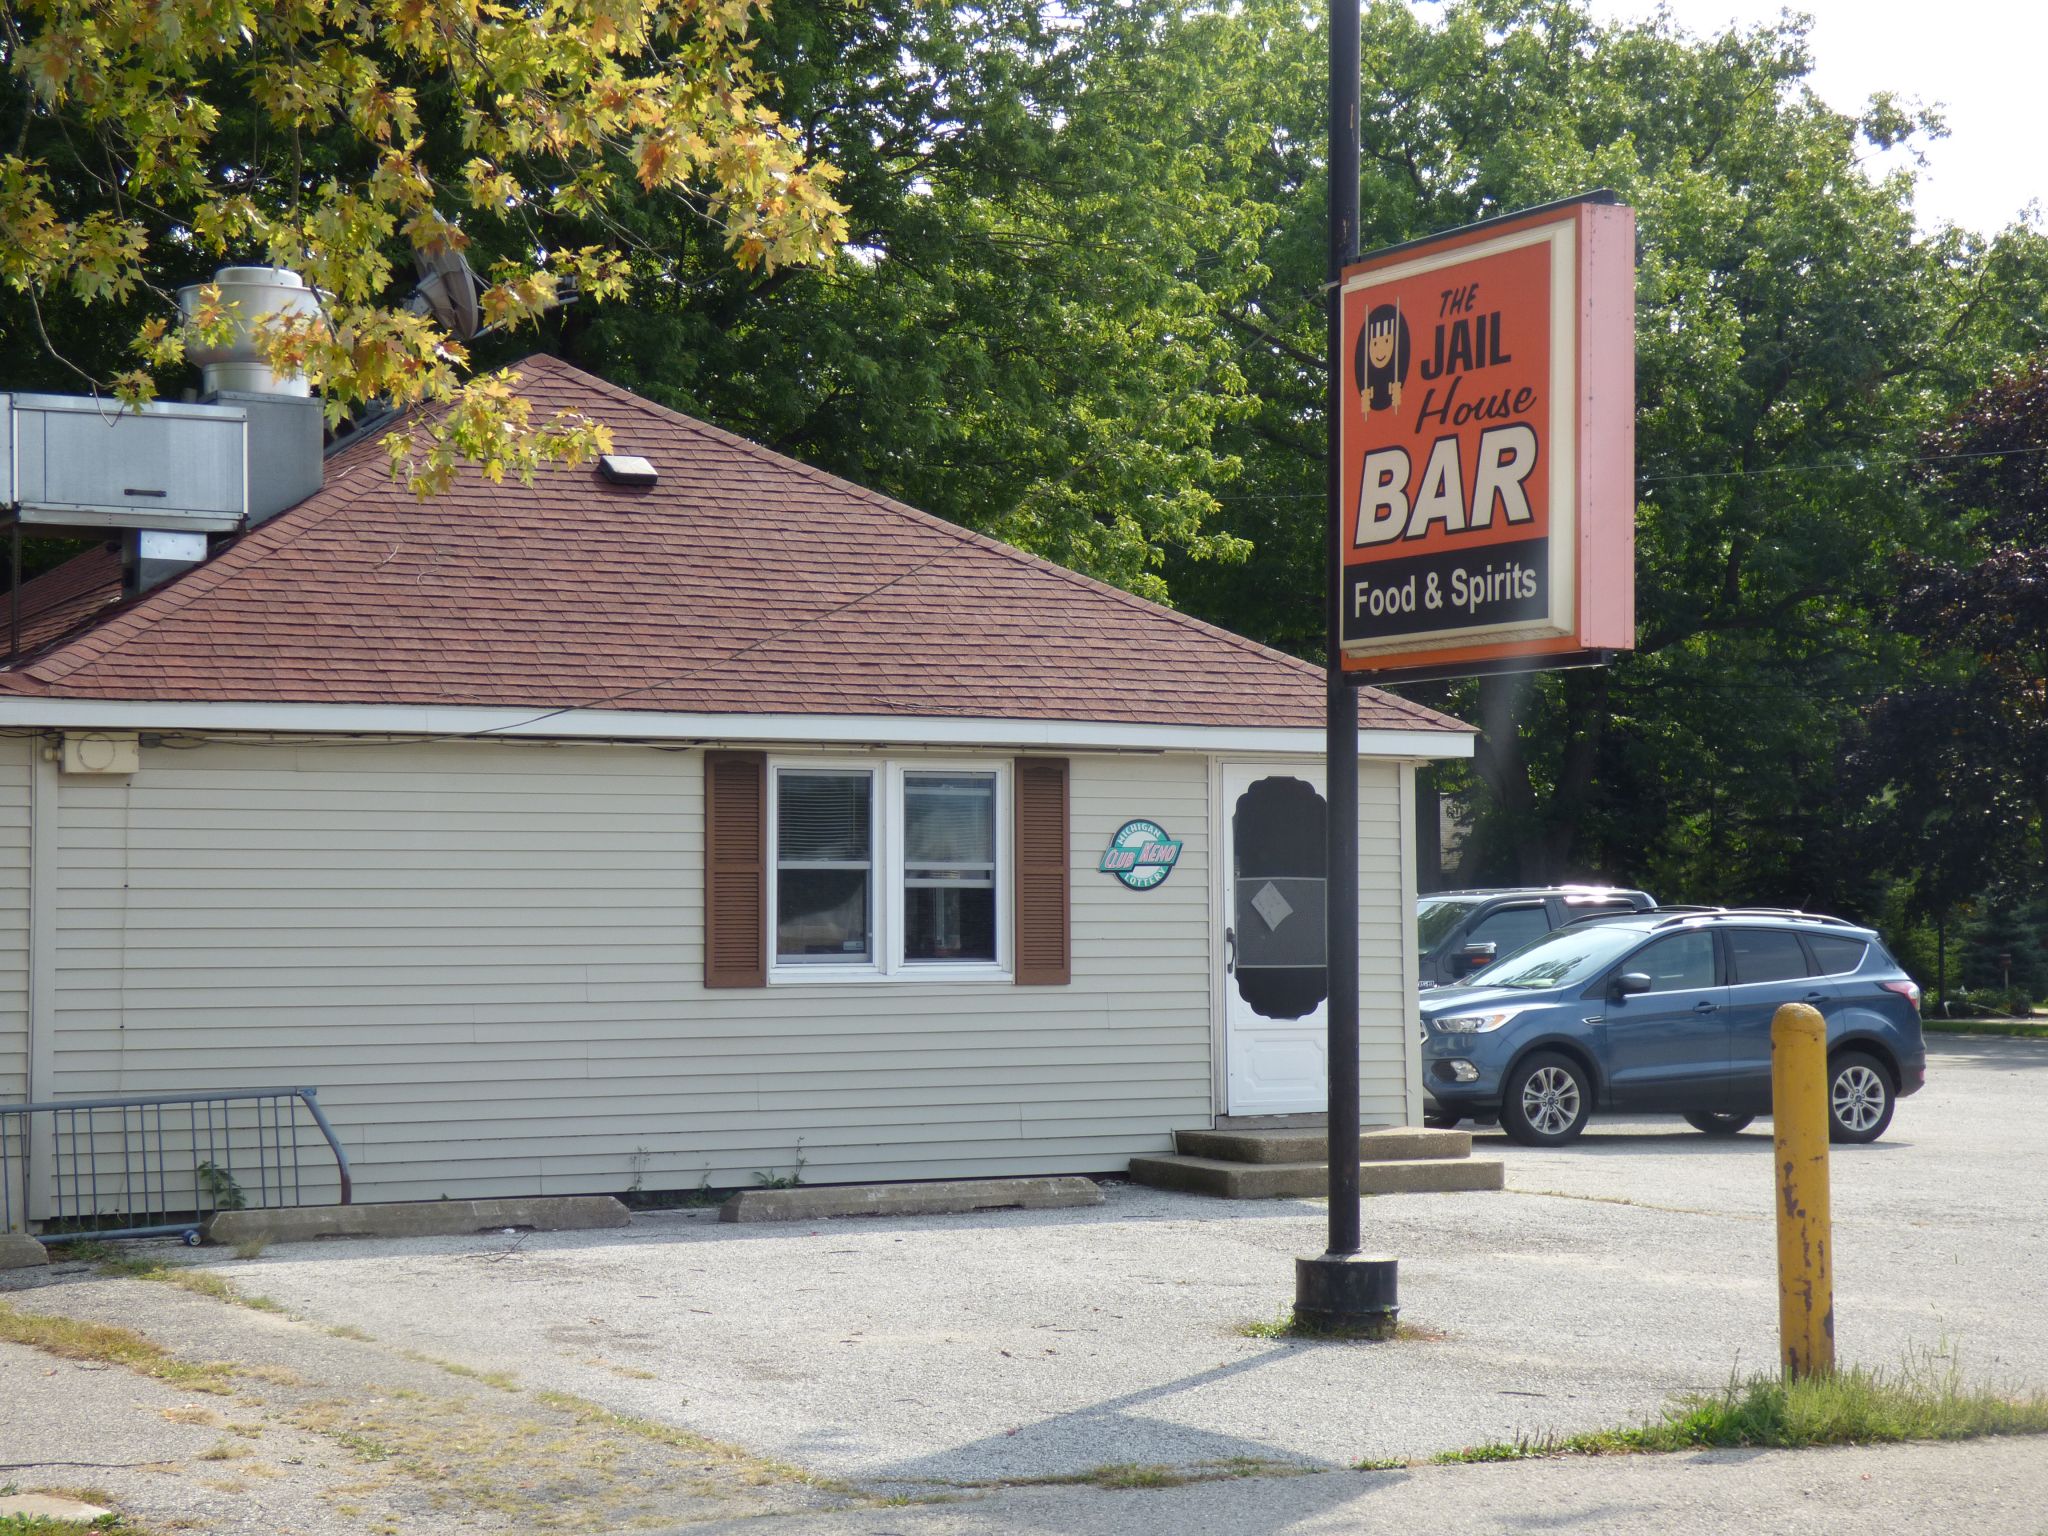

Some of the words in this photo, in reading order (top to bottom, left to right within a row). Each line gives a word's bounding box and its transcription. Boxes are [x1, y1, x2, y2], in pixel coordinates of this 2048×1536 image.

[1440, 282, 1479, 318] THE
[1420, 311, 1512, 381] JAIL
[1414, 375, 1537, 434] House
[1353, 421, 1539, 549] BAR
[1354, 575, 1416, 619] Food
[1424, 570, 1443, 610] &
[1451, 561, 1537, 615] Spirits
[1104, 848, 1136, 869] CLUB
[1139, 842, 1177, 863] KENO
[1117, 823, 1162, 845] MICHIGAN
[1124, 867, 1166, 887] LOTTERY
